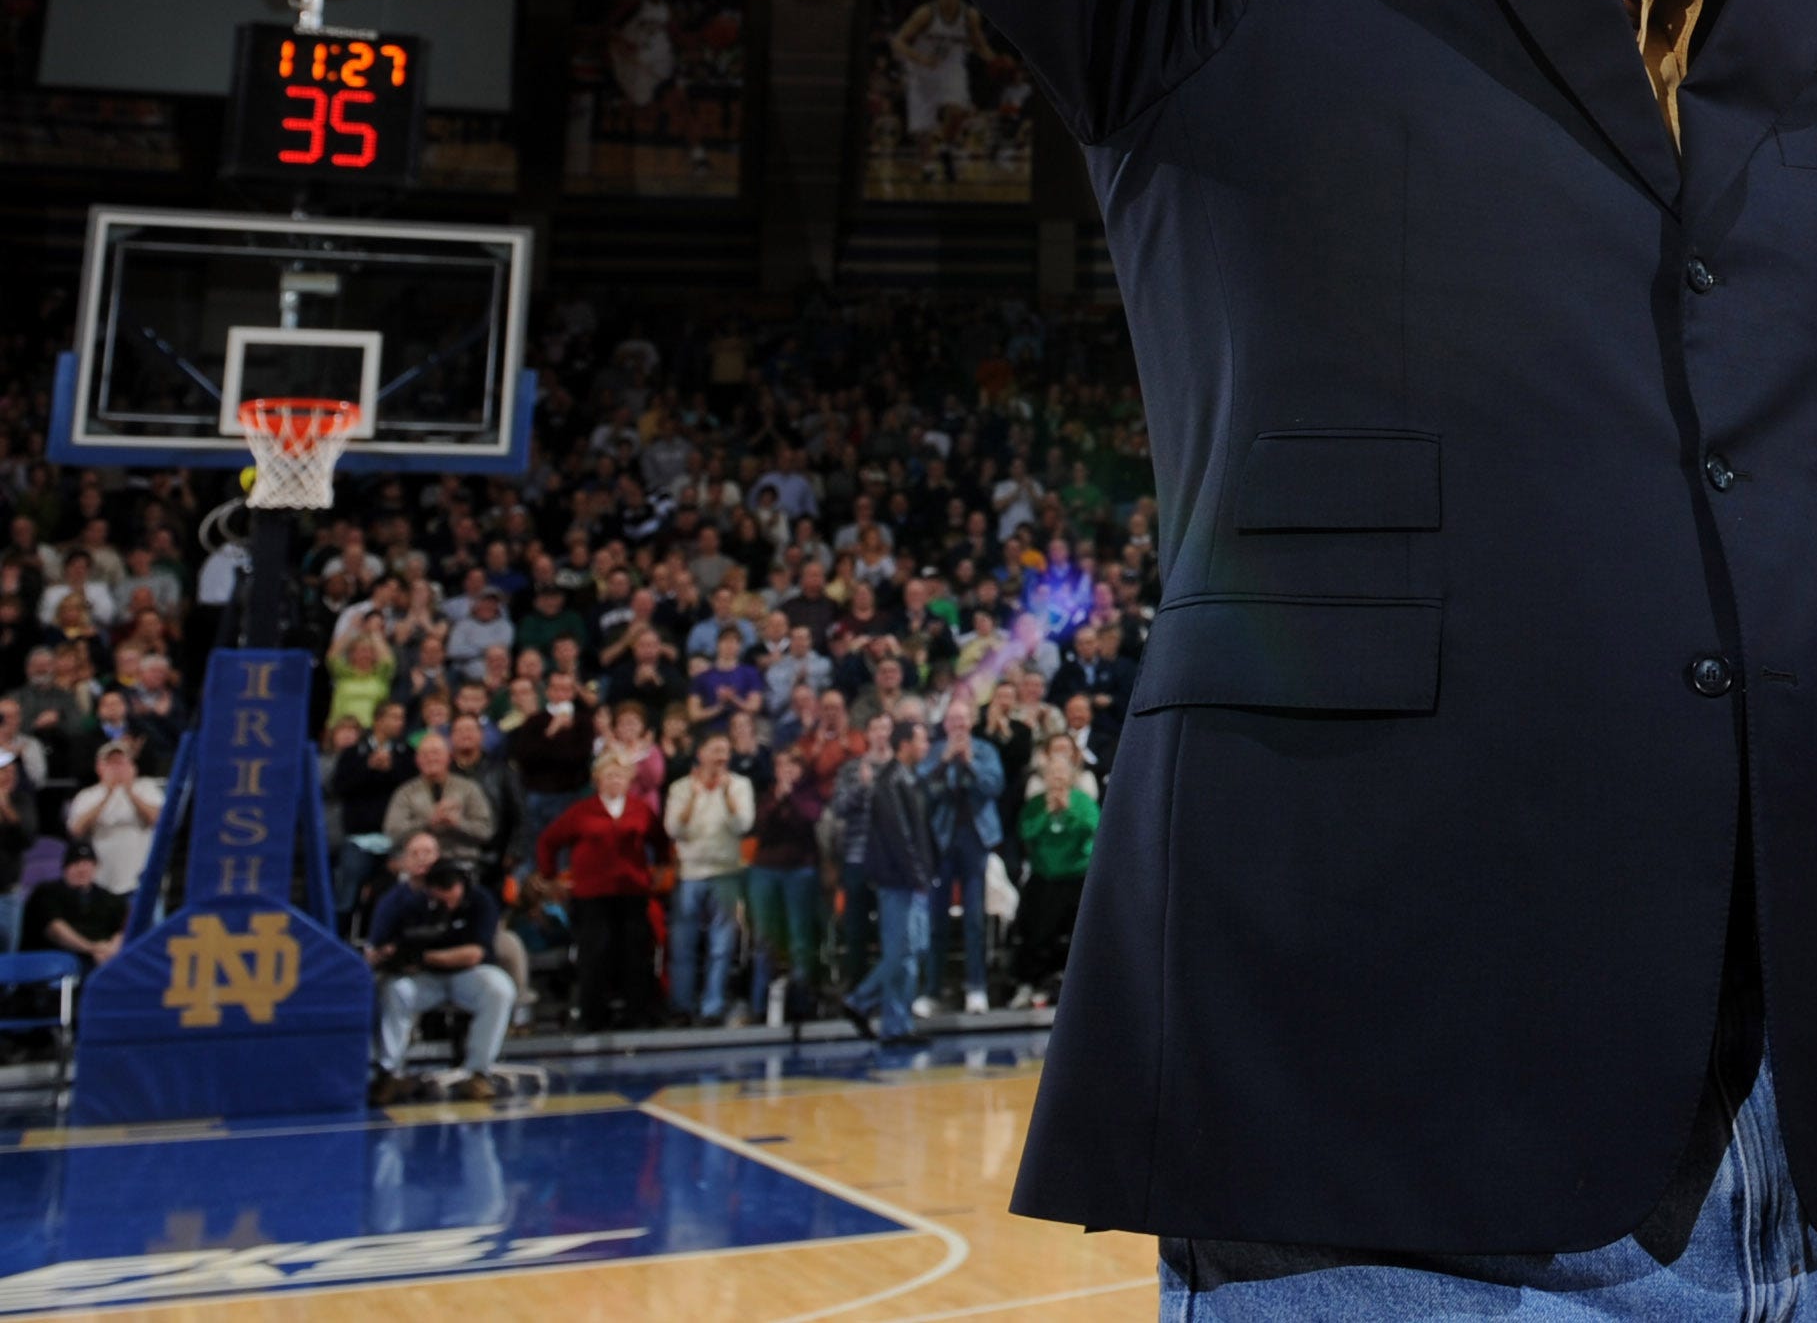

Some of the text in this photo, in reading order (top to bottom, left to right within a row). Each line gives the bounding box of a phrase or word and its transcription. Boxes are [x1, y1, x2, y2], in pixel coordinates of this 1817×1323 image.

[279, 39, 407, 88] 11:27
[277, 85, 379, 168] 35
[217, 661, 282, 896] IRISH
